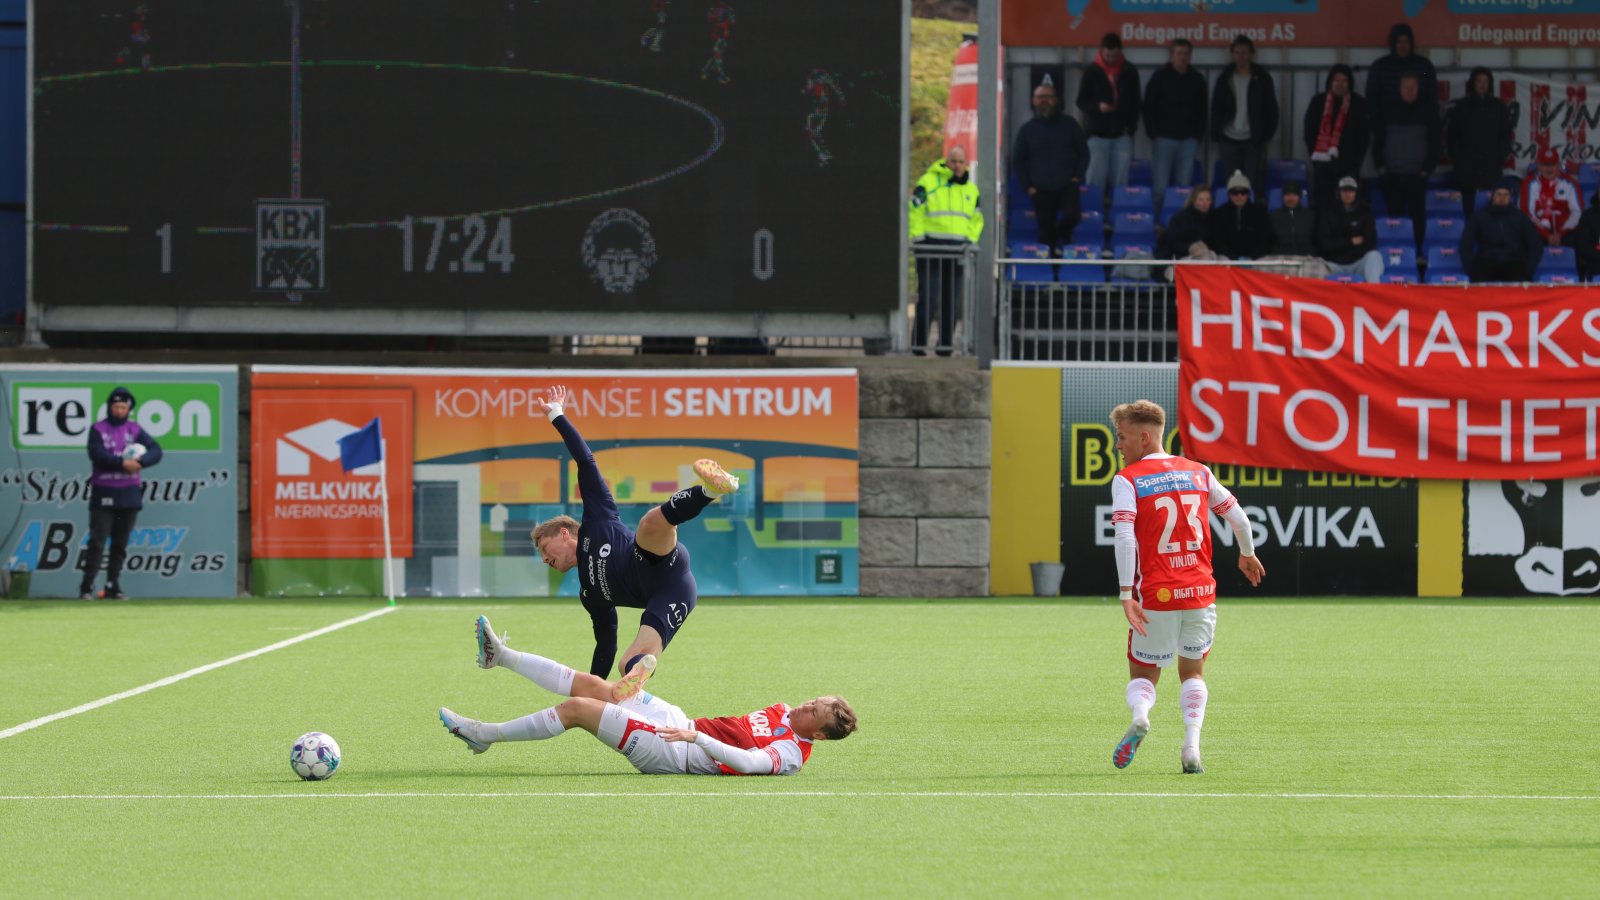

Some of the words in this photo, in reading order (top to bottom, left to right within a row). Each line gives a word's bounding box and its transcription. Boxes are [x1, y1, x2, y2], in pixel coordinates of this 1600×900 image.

[1122, 23, 1203, 43] Ødegaard
[1271, 24, 1296, 41] AS
[1459, 23, 1542, 45] Ødegaard
[156, 223, 172, 274] 1
[400, 215, 514, 272] 17:24
[753, 227, 774, 280] 0
[435, 387, 642, 418] KOMPEANSE
[664, 387, 833, 417] SENTRUM
[1188, 376, 1600, 462] STOLTHET
[1136, 472, 1190, 488] SpareBank
[1154, 482, 1193, 493] ØSTLANDET
[275, 504, 387, 519] NÆRINGSPAR
[1154, 493, 1204, 554] 23
[8, 520, 74, 571] AB
[190, 554, 225, 571] as
[1174, 587, 1194, 600] RIGHT
[1195, 586, 1204, 597] TO
